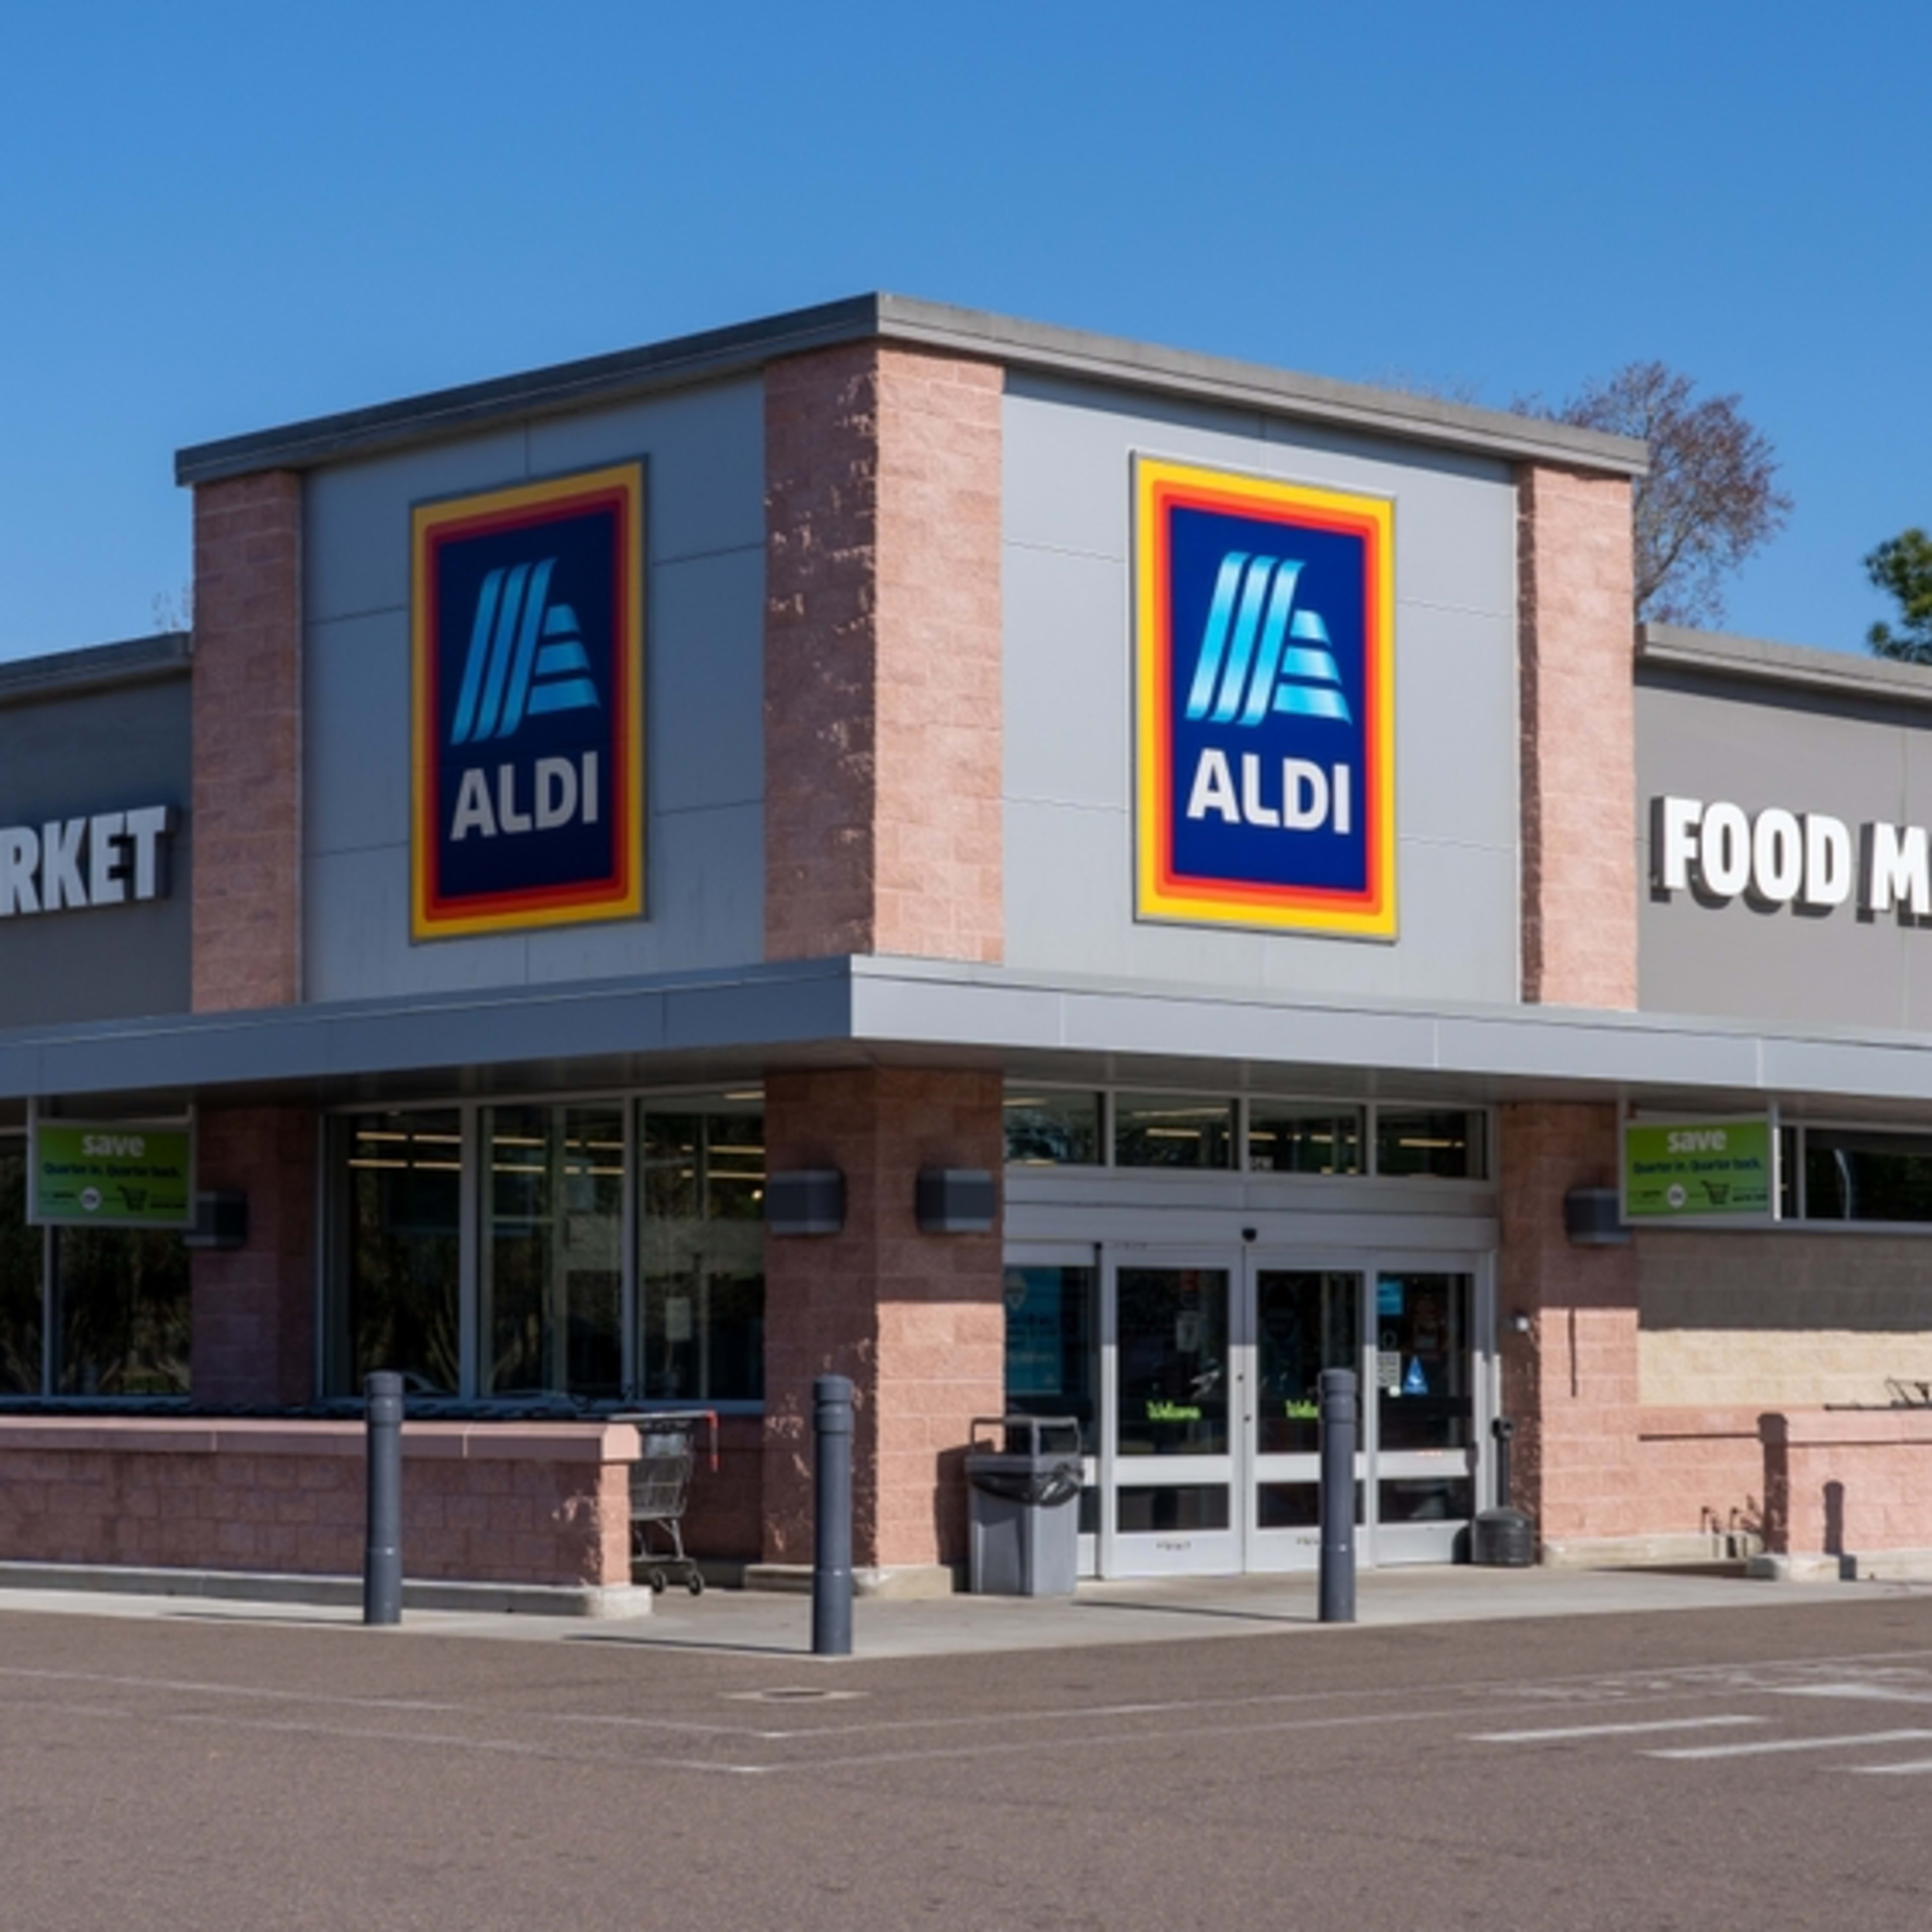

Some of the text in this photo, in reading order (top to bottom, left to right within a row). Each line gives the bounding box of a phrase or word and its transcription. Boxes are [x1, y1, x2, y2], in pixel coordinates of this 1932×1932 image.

[450, 751, 598, 841] ALDI
[1186, 747, 1351, 835] ALDI
[0, 805, 167, 916] RKET
[1663, 796, 1852, 905] FOOD
[82, 1134, 145, 1157] save
[1666, 1129, 1727, 1154] save
